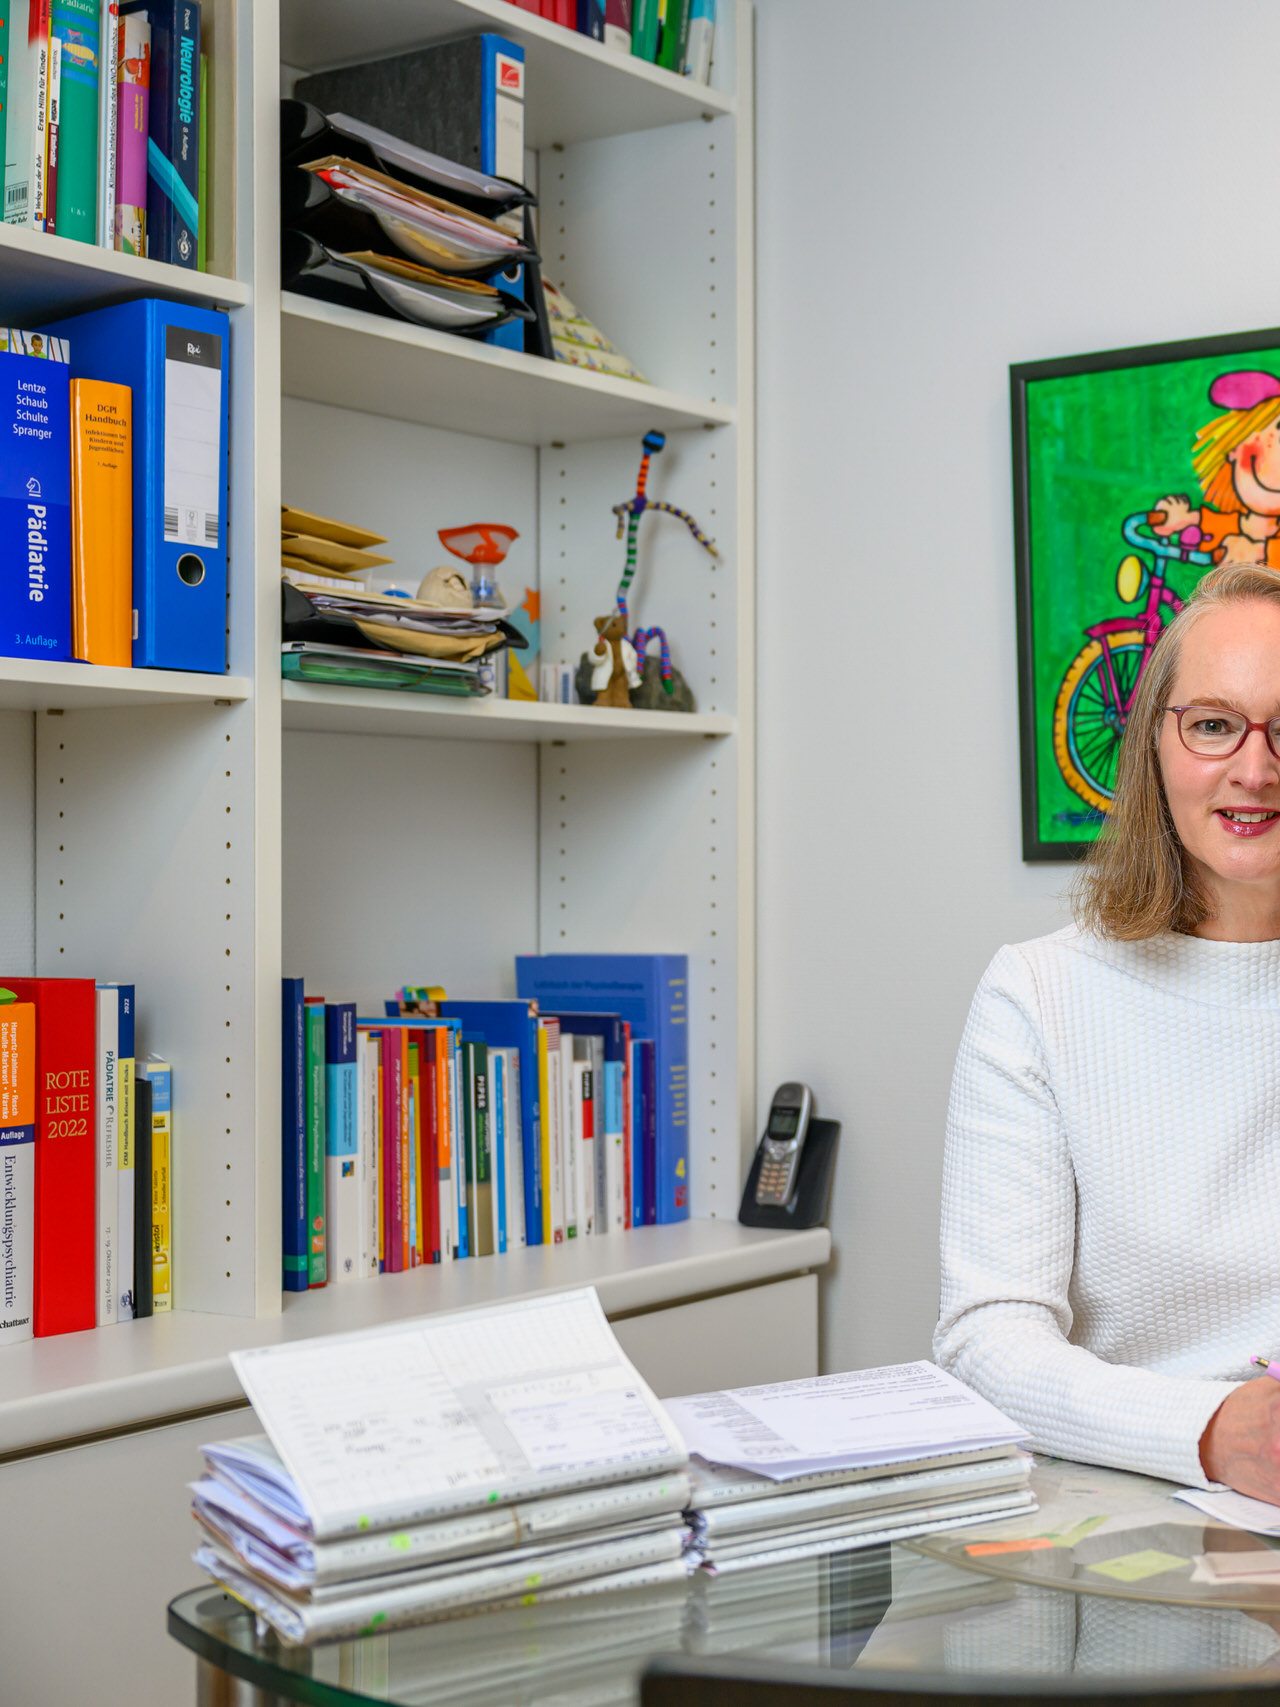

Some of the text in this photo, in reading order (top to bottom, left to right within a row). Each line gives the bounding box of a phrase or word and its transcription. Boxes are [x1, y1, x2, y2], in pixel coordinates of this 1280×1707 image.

[178, 36, 194, 124] Neurologie
[18, 380, 46, 394] Lentze
[16, 394, 48, 409] Schaub
[97, 404, 117, 414] DGPI
[16, 409, 48, 424] Schulte
[86, 414, 126, 427] Handbuch
[13, 424, 52, 440] Spranger
[89, 437, 112, 445] Kindern
[28, 504, 48, 602] Pädiatrie
[15, 634, 58, 648] 3. Auflage
[46, 1070, 90, 1090] ROTE
[106, 1050, 114, 1102] PÄDIATRIE
[477, 1075, 486, 1108] PIPER
[46, 1094, 89, 1114] LISTE
[1, 1131, 24, 1140] Auflage
[48, 1118, 87, 1138] 2022
[2, 1155, 16, 1308] Entwicklungspsychiatrie
[0, 1317, 29, 1329] chattauer
